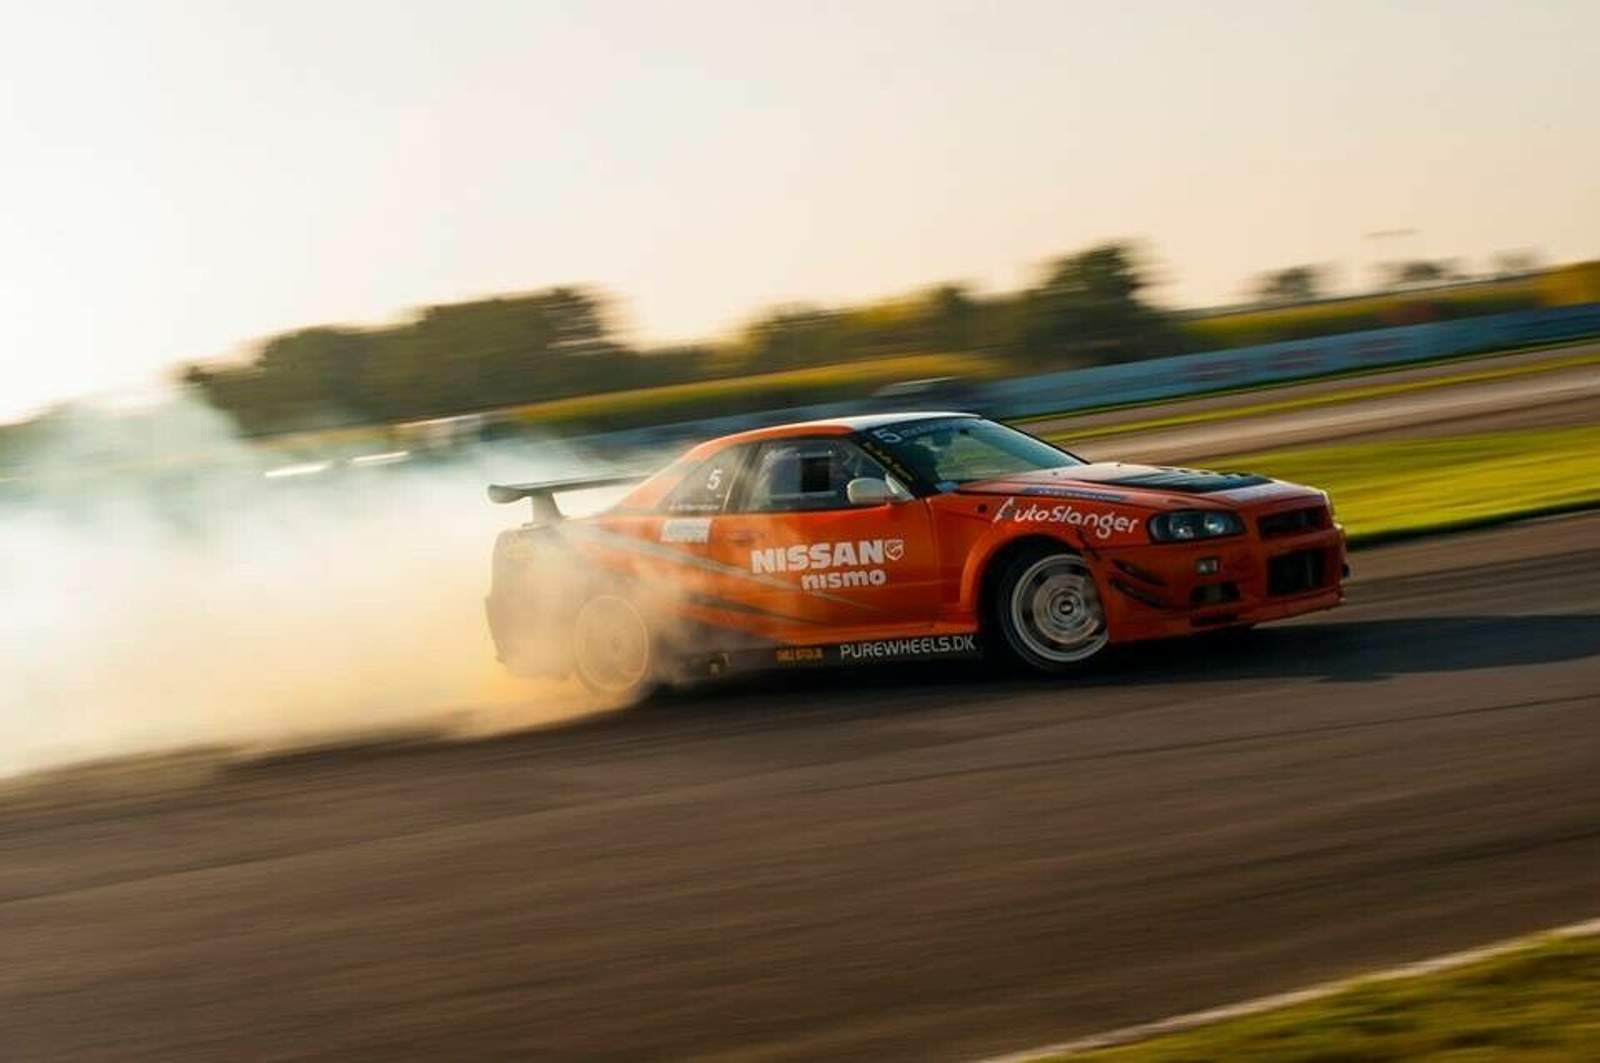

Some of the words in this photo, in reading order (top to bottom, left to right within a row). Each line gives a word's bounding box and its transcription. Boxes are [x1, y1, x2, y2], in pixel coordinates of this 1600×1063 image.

[871, 428, 902, 443] 5
[706, 469, 723, 490] 5
[751, 540, 885, 574] NISSAN
[801, 569, 886, 590] nismo
[840, 635, 976, 659] PUREWHEELS.DK
